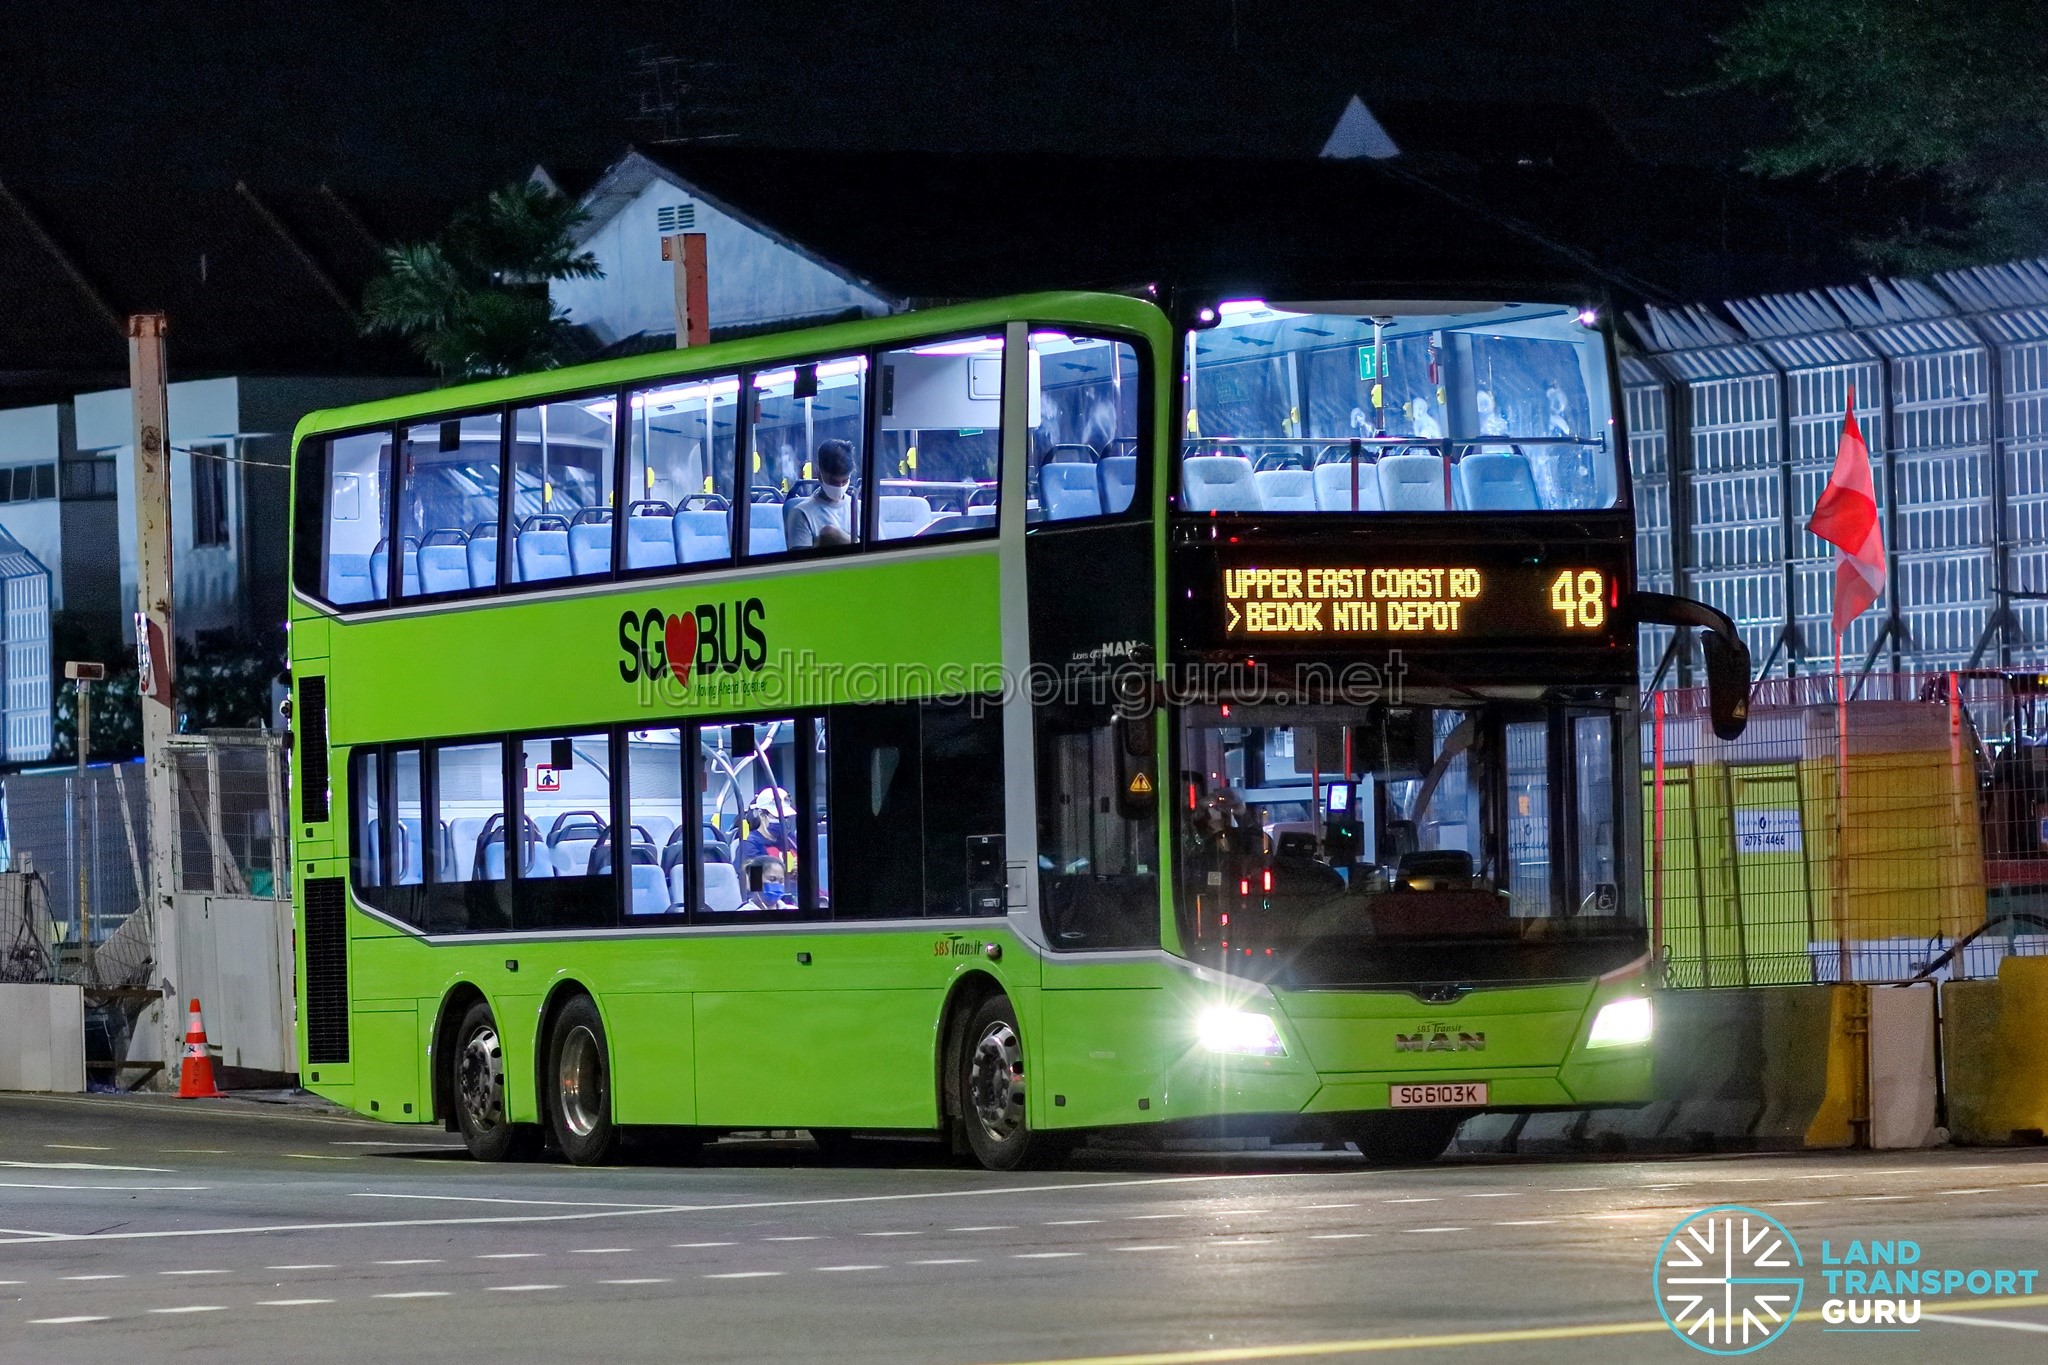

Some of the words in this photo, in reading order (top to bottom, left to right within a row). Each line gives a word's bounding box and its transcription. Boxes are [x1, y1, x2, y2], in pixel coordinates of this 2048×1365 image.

[1225, 569, 1302, 598] UPPER
[1307, 569, 1366, 598] EAST
[1371, 569, 1445, 598] COAST
[1449, 569, 1481, 598] RD
[1551, 570, 1605, 628] 48
[1333, 601, 1378, 631] NTH
[1388, 601, 1460, 631] DEPOT
[1103, 640, 1136, 657] MAN
[934, 940, 949, 957] SBS
[948, 935, 982, 958] Transit
[1416, 1025, 1431, 1033] SBS
[1430, 1022, 1463, 1033] Transit
[1395, 1032, 1486, 1053] MAN
[1400, 1086, 1478, 1104] SG6103K
